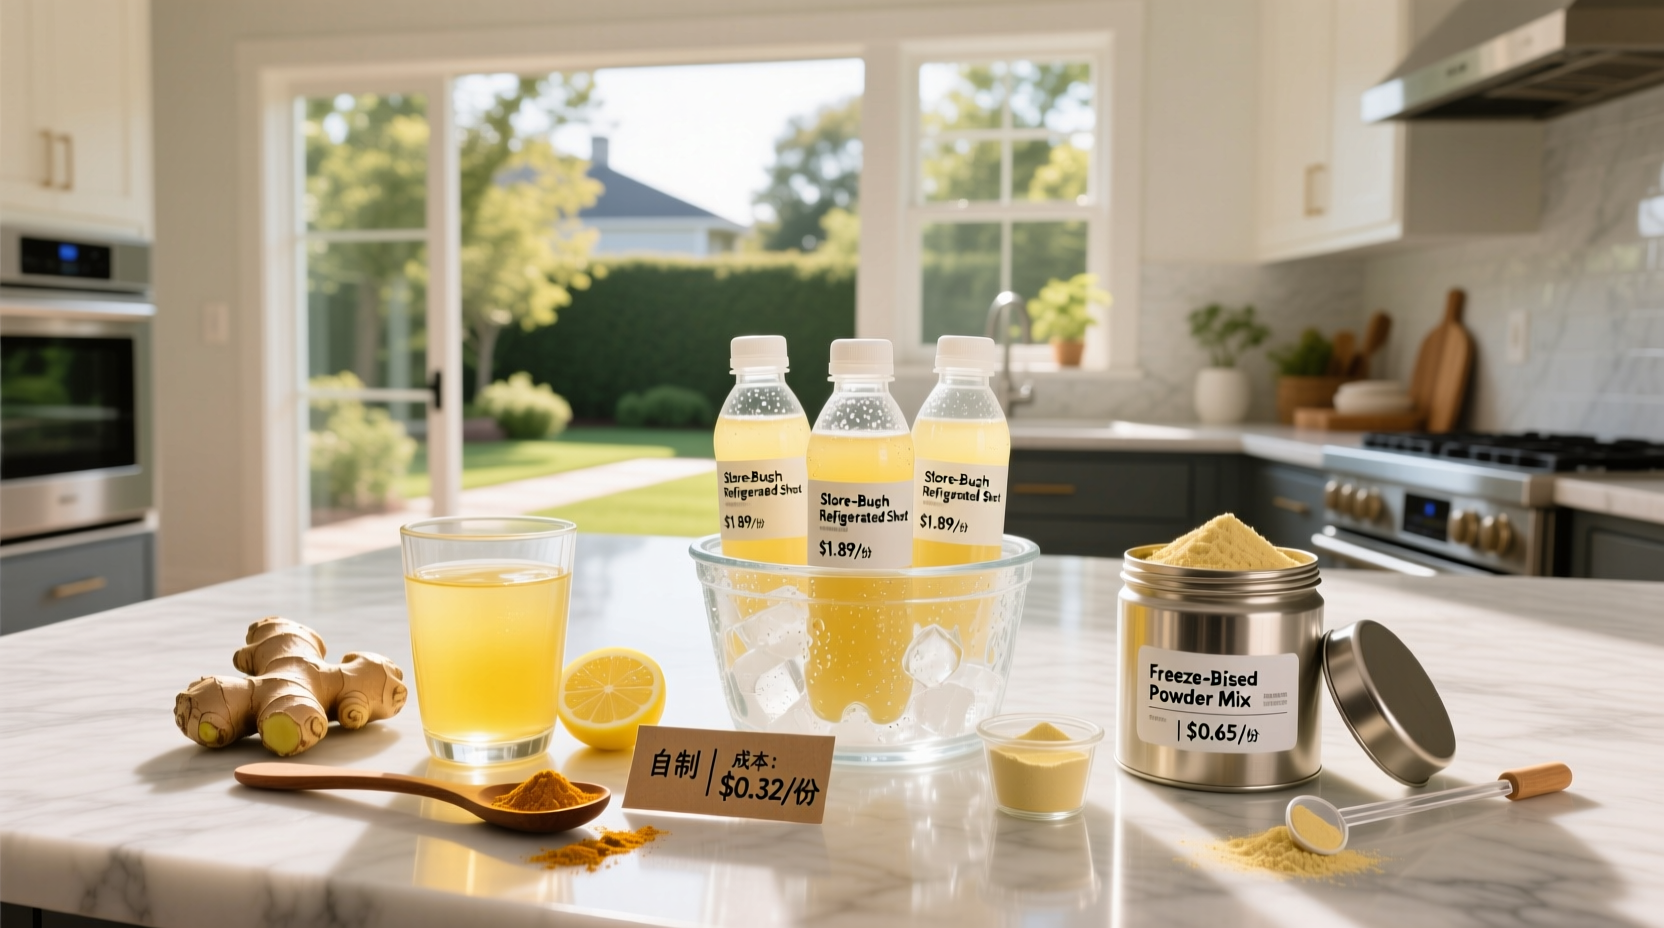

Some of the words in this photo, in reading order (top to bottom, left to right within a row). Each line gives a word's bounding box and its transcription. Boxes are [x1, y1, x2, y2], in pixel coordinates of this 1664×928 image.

[1150, 663, 1258, 687] Freeze-Bised
[1150, 684, 1214, 706] Powder
[1218, 690, 1252, 708] Mix
[651, 748, 701, 780] 自制
[718, 770, 821, 806] $0.32/份
